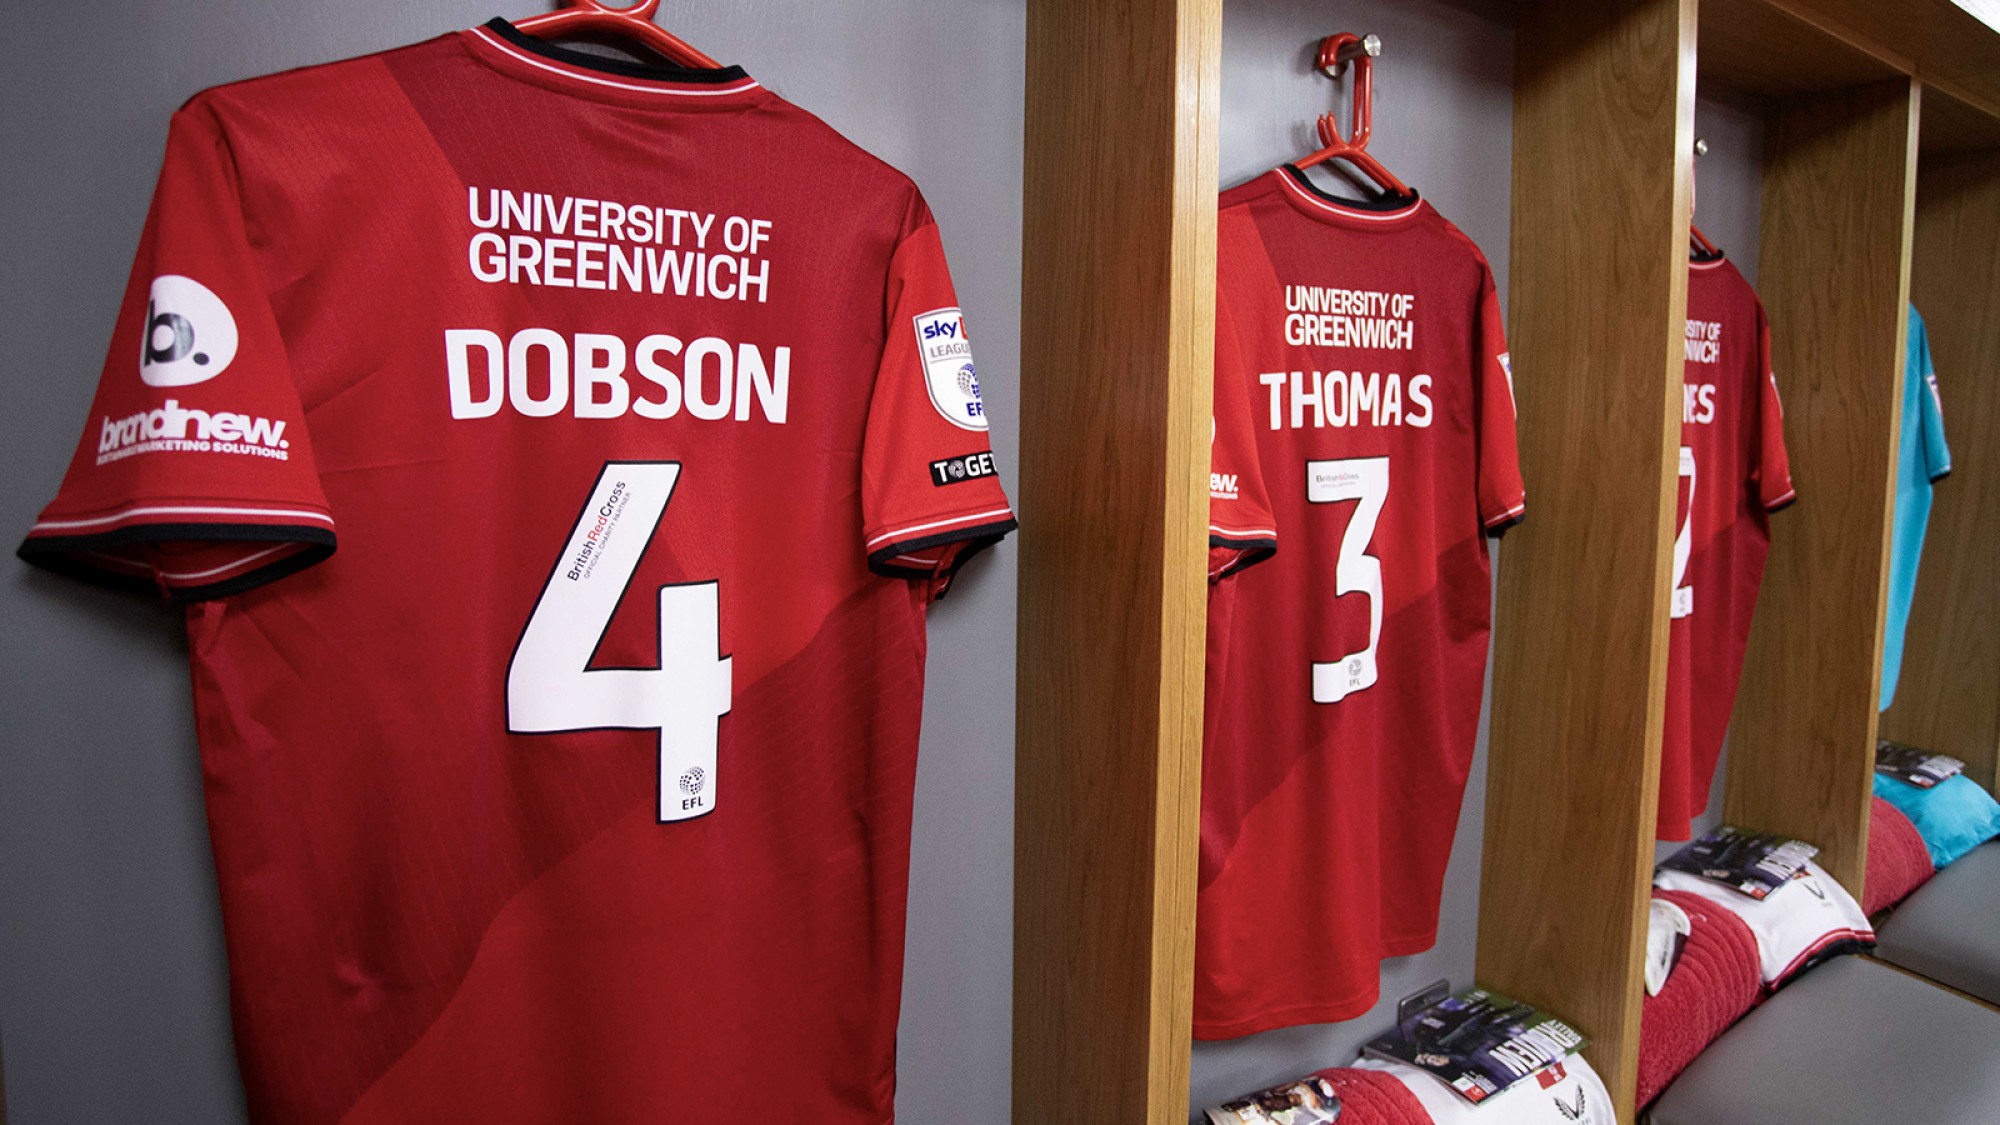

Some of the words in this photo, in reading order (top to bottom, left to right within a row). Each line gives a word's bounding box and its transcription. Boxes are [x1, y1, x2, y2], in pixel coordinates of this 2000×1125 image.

[468, 186, 716, 249] UNIVERSITY
[723, 216, 773, 255] OF
[468, 232, 771, 303] GREENWICH
[1285, 284, 1390, 317] UNIVERSITY
[1391, 293, 1415, 319] OF
[923, 319, 957, 339] sky
[1284, 313, 1414, 350] GREENWICH
[930, 343, 969, 358] LEAGU
[445, 327, 791, 424] DOBSON
[965, 402, 985, 417] EF
[1259, 370, 1433, 431] THOMAS
[1682, 383, 1716, 425] NES
[212, 441, 288, 461] SOLUTIONS
[1306, 455, 1390, 703] 3
[506, 460, 733, 825] 4
[682, 796, 704, 811] EFL
